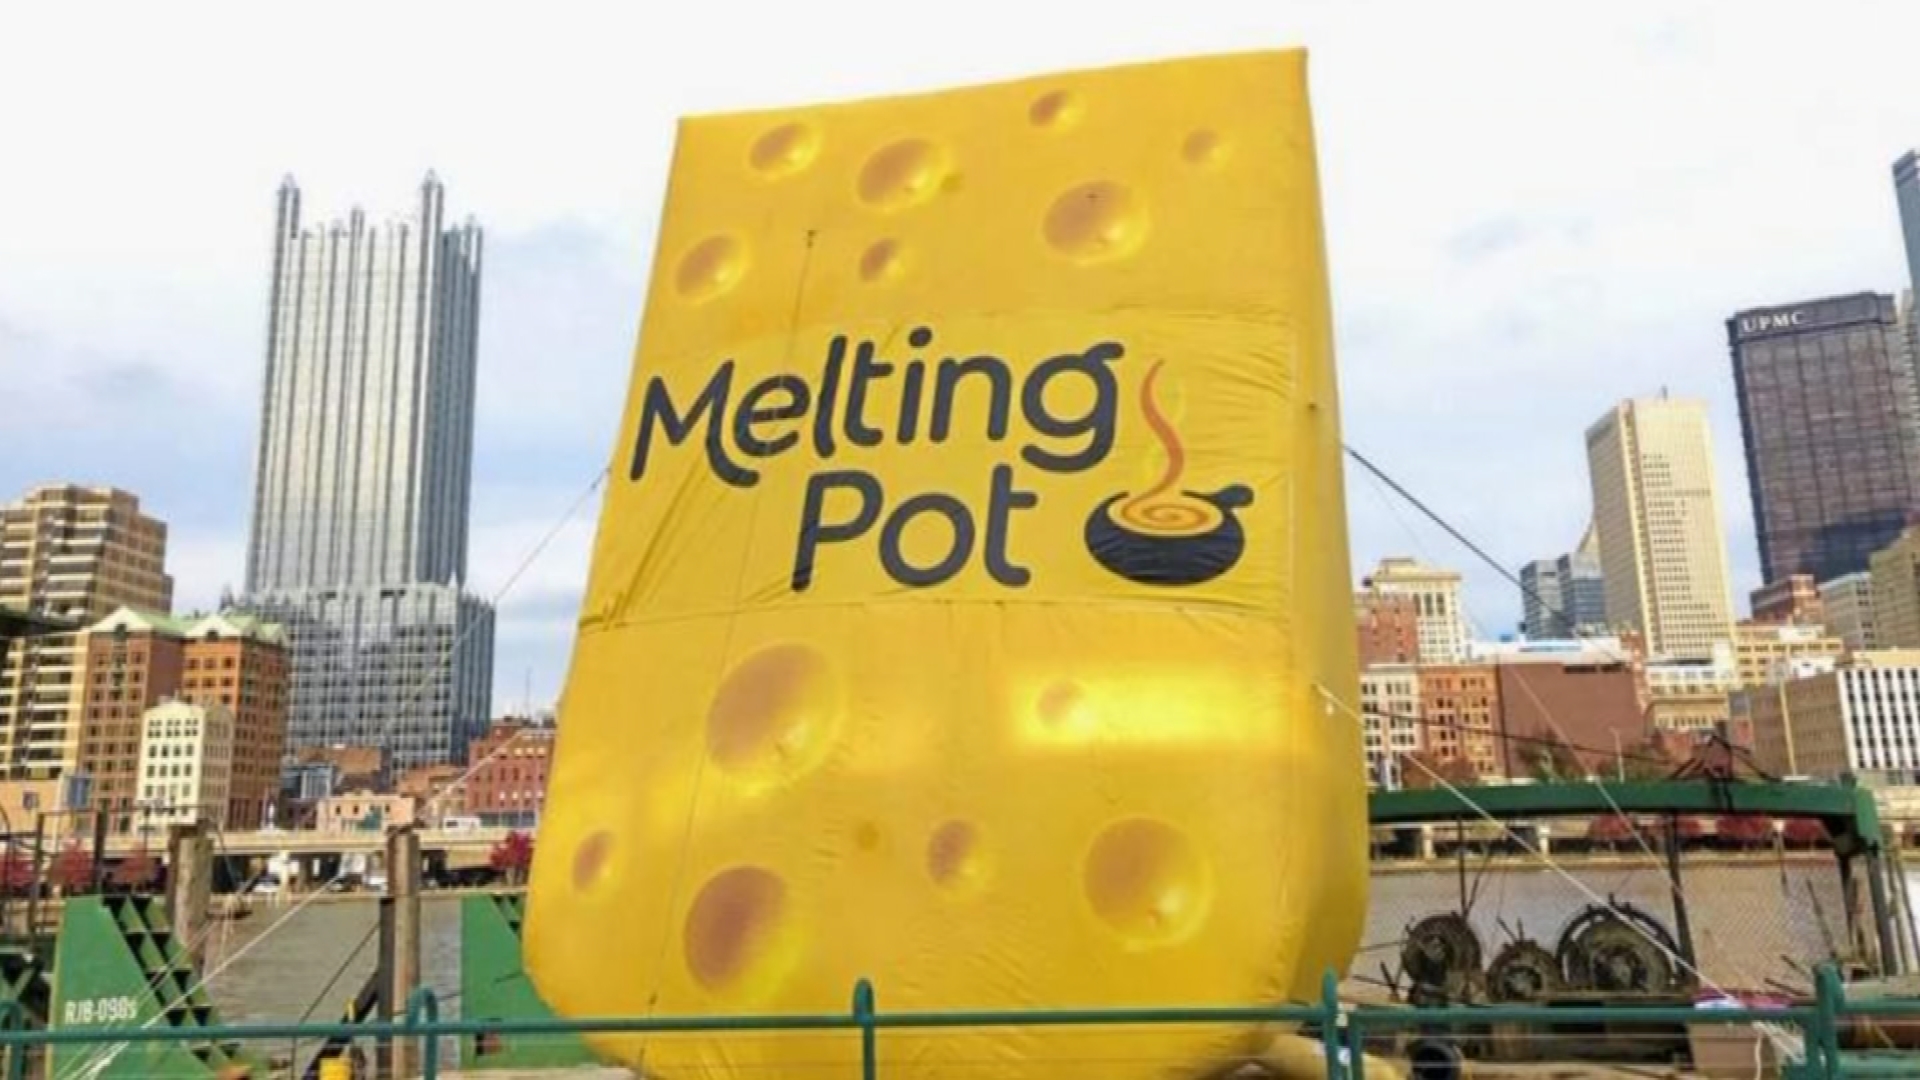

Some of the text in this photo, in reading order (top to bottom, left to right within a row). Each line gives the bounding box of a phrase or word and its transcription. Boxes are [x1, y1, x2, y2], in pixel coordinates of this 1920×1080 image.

[1742, 310, 1804, 332] UPMC
[629, 327, 1125, 487] Melting
[791, 464, 1038, 592] Pot
